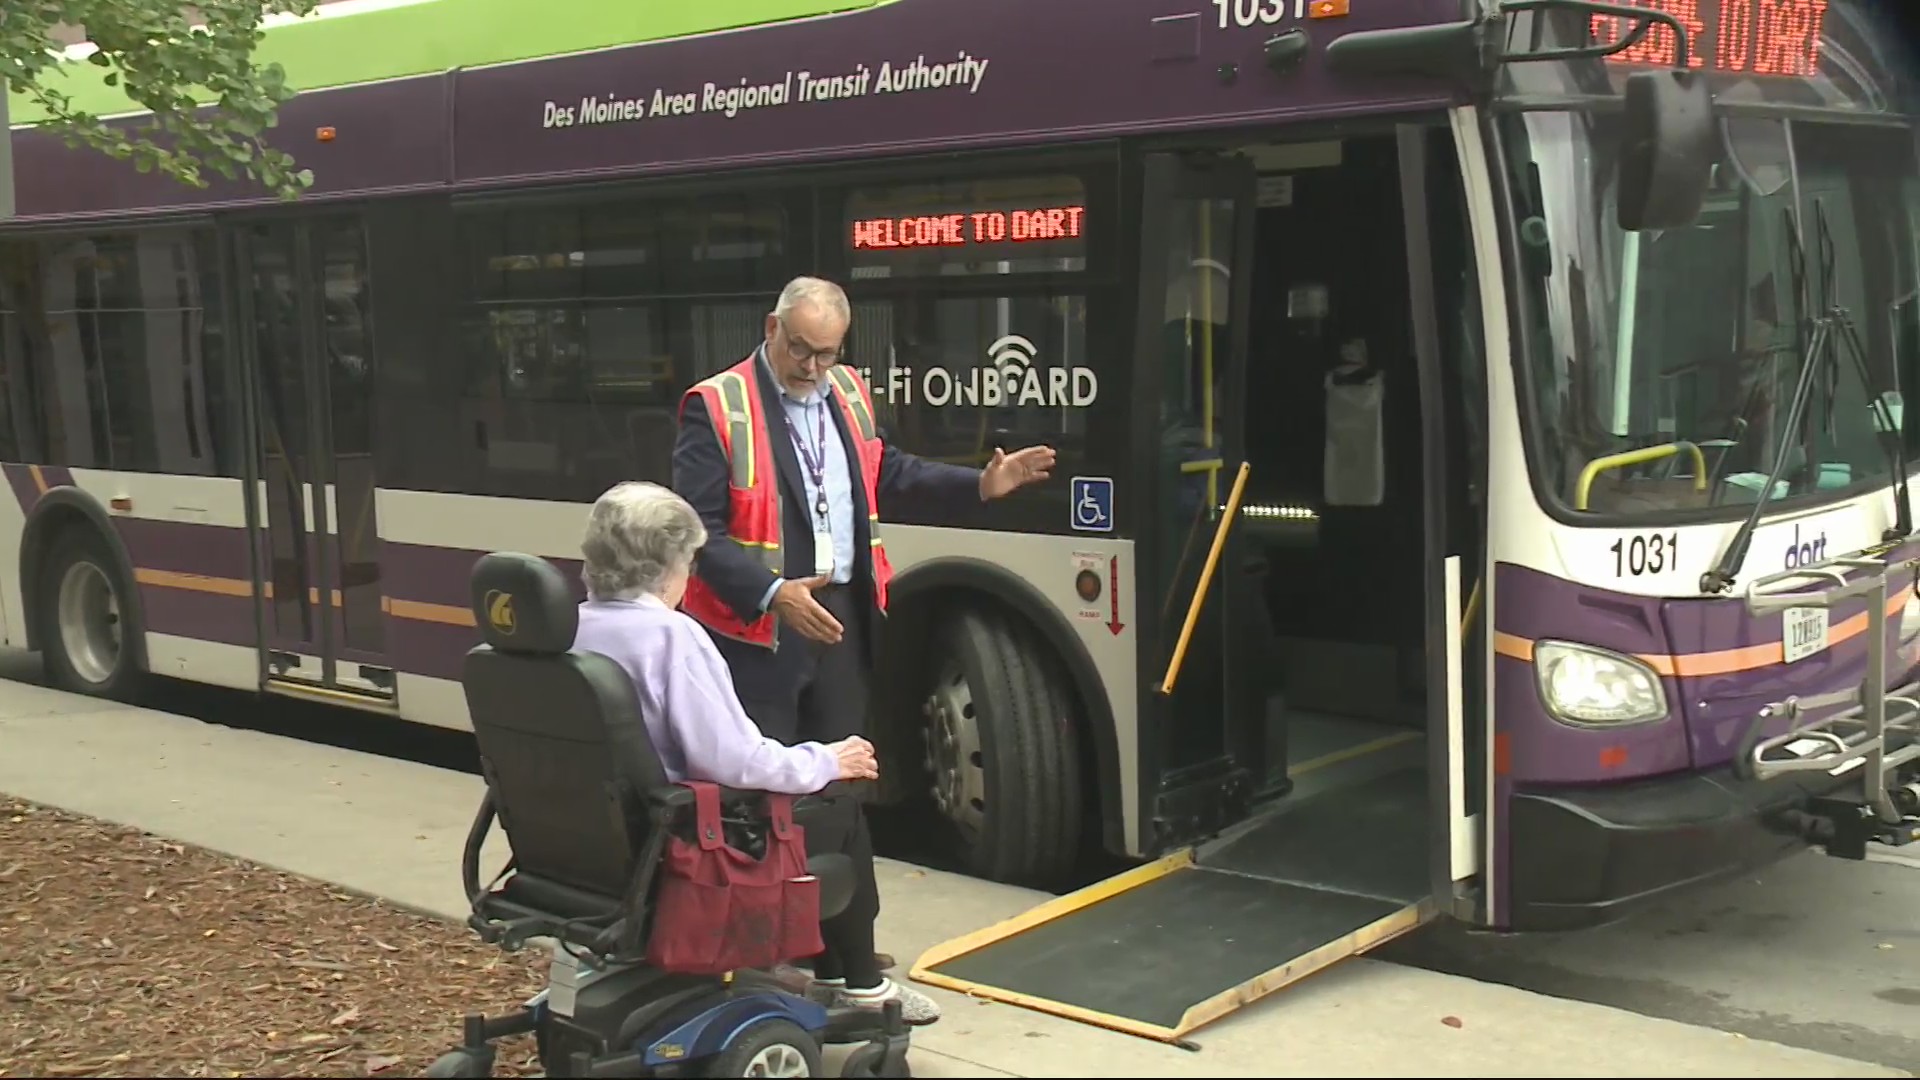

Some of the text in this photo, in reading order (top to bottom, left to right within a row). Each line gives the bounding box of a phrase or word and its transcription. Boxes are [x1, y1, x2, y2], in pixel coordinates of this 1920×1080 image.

[1212, 0, 1304, 28] 1031
[543, 50, 989, 129] Des Moines Area Regional Transit Authority
[853, 205, 1085, 248] WELCOME TO DART
[857, 366, 913, 405] i-Fi
[1610, 532, 1679, 578] 1031
[1784, 523, 1828, 570] dart
